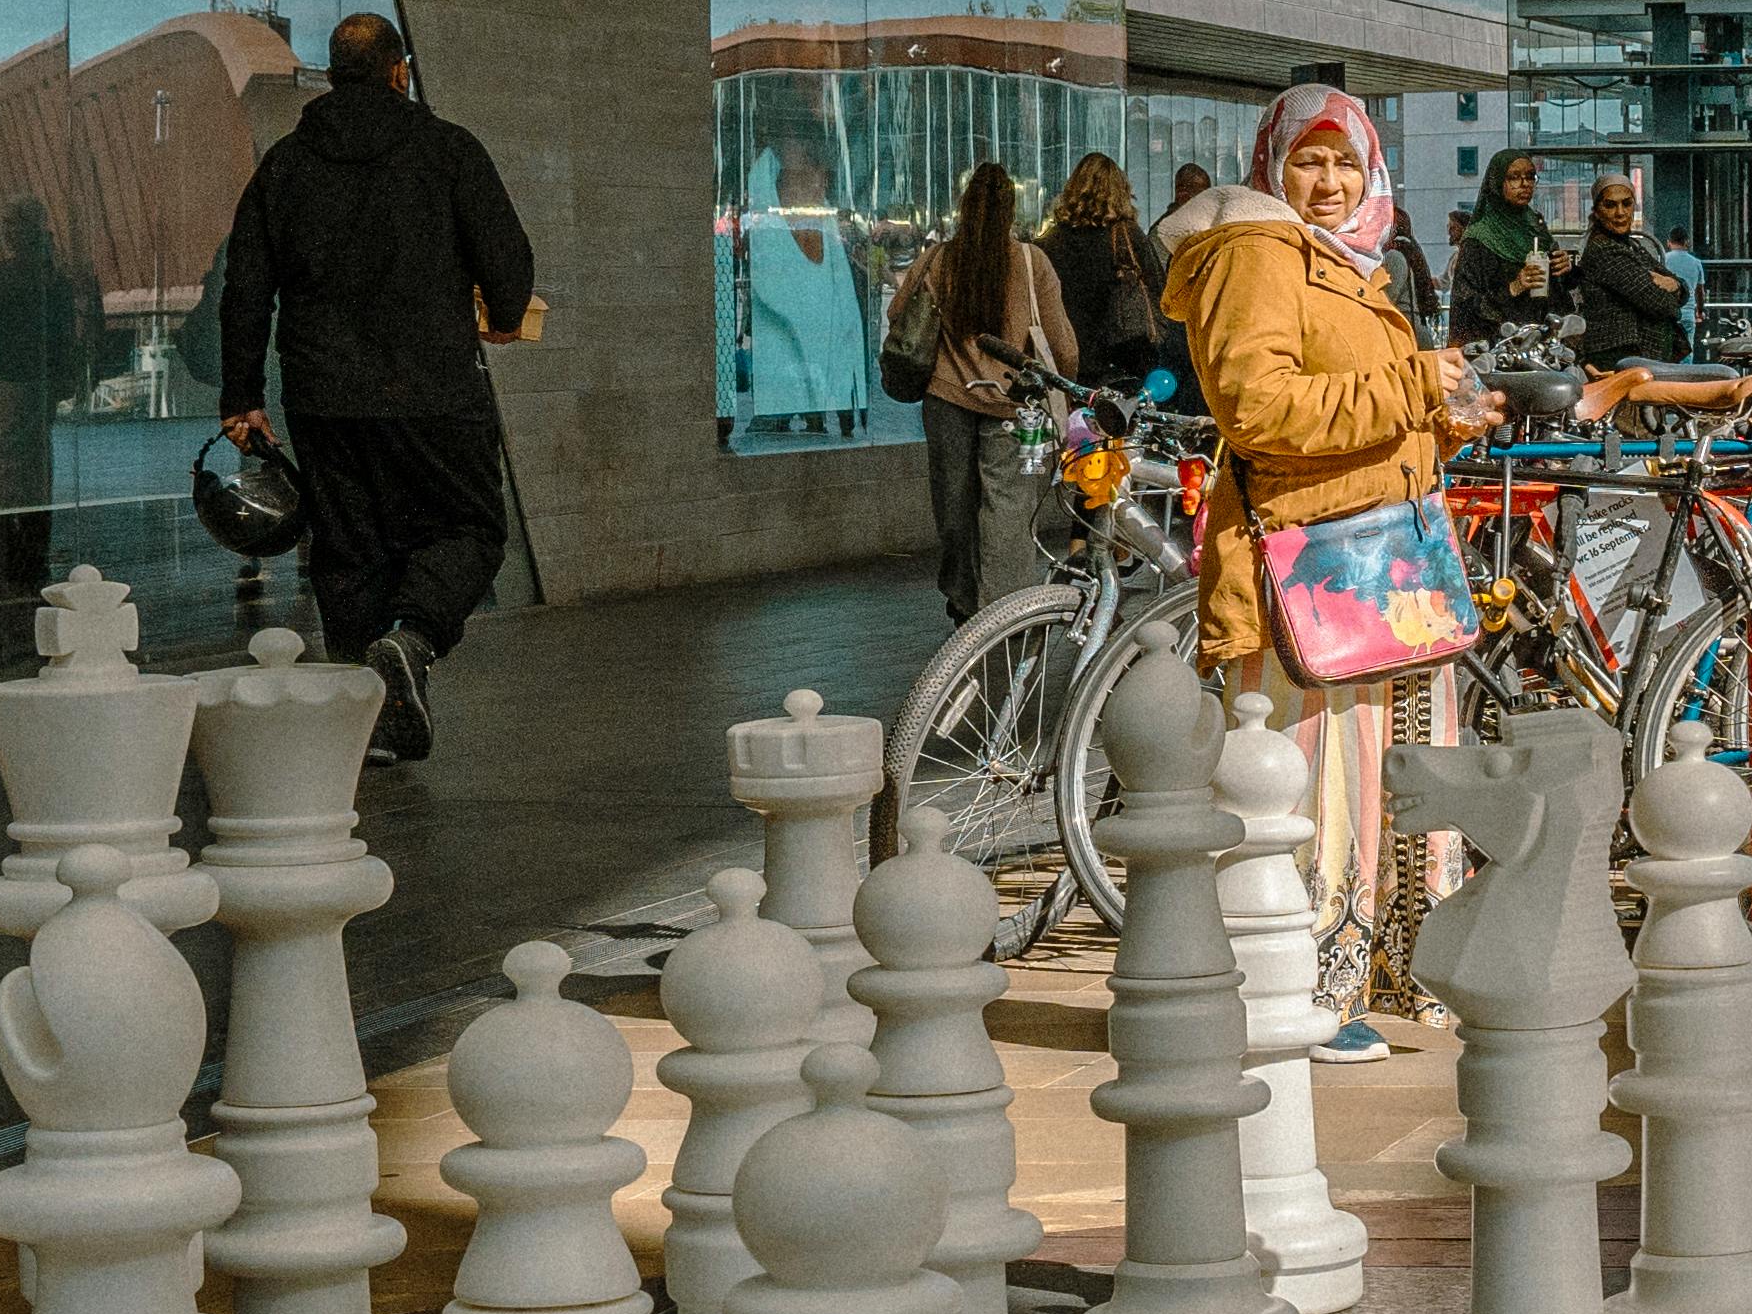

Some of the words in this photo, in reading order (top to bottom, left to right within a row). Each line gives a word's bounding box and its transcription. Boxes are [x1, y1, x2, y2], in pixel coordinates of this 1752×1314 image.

[1587, 508, 1609, 523] bike
[1608, 496, 1634, 514] racks
[1586, 531, 1598, 543] be
[1598, 509, 1638, 537] replaced
[1589, 547, 1600, 559] 16
